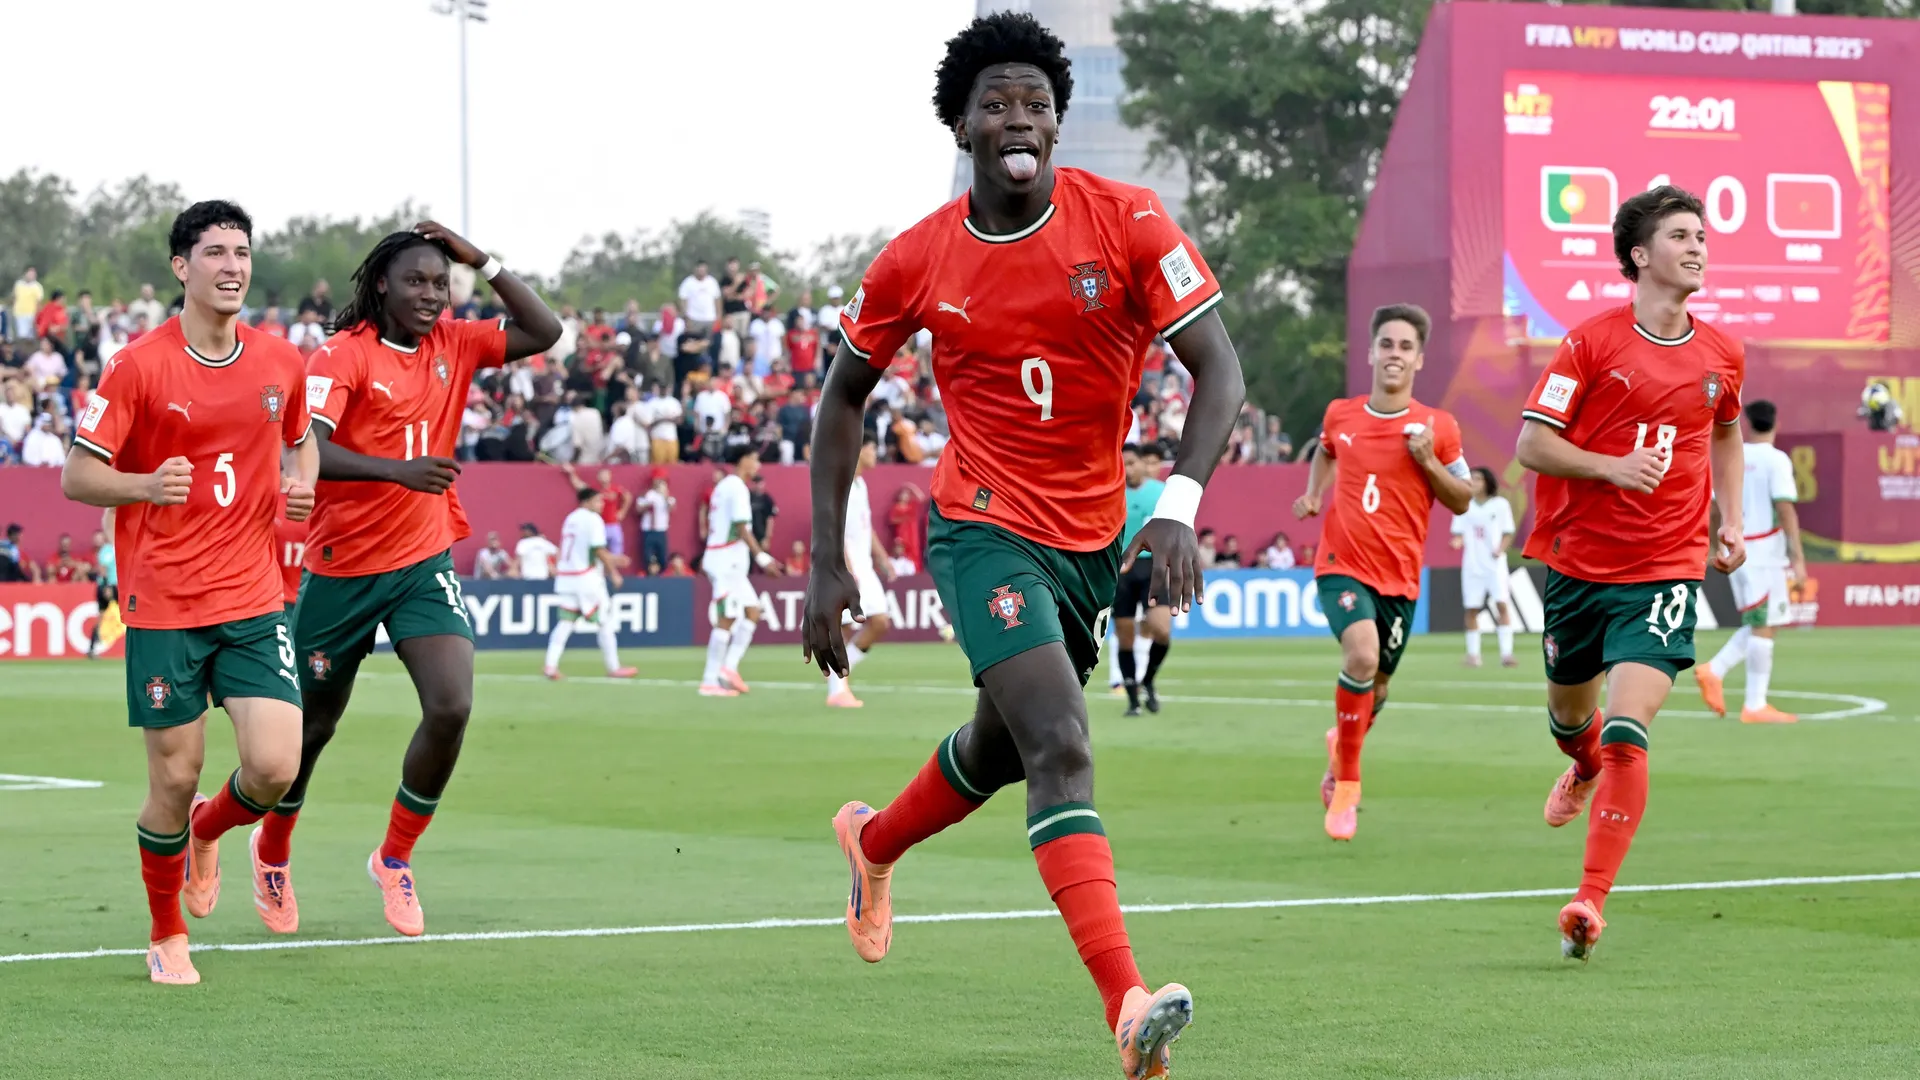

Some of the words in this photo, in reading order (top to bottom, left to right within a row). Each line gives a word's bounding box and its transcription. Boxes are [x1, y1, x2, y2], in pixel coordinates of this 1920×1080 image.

[1525, 24, 1573, 48] FIFA
[1618, 28, 1697, 52] WORLD
[1697, 32, 1740, 54] CUP
[1741, 33, 1812, 59] QATAR
[1649, 96, 1735, 130] 22:01
[1705, 175, 1748, 234] 0
[1021, 357, 1054, 422] 9
[404, 420, 429, 461] 11
[1634, 423, 1677, 475] 18
[214, 453, 236, 507] 5
[1361, 474, 1380, 514] 6
[284, 541, 305, 567] 17
[1646, 584, 1688, 629] 18
[1844, 584, 1884, 607] FIFA
[276, 625, 295, 668] 5
[1388, 616, 1403, 650] 6
